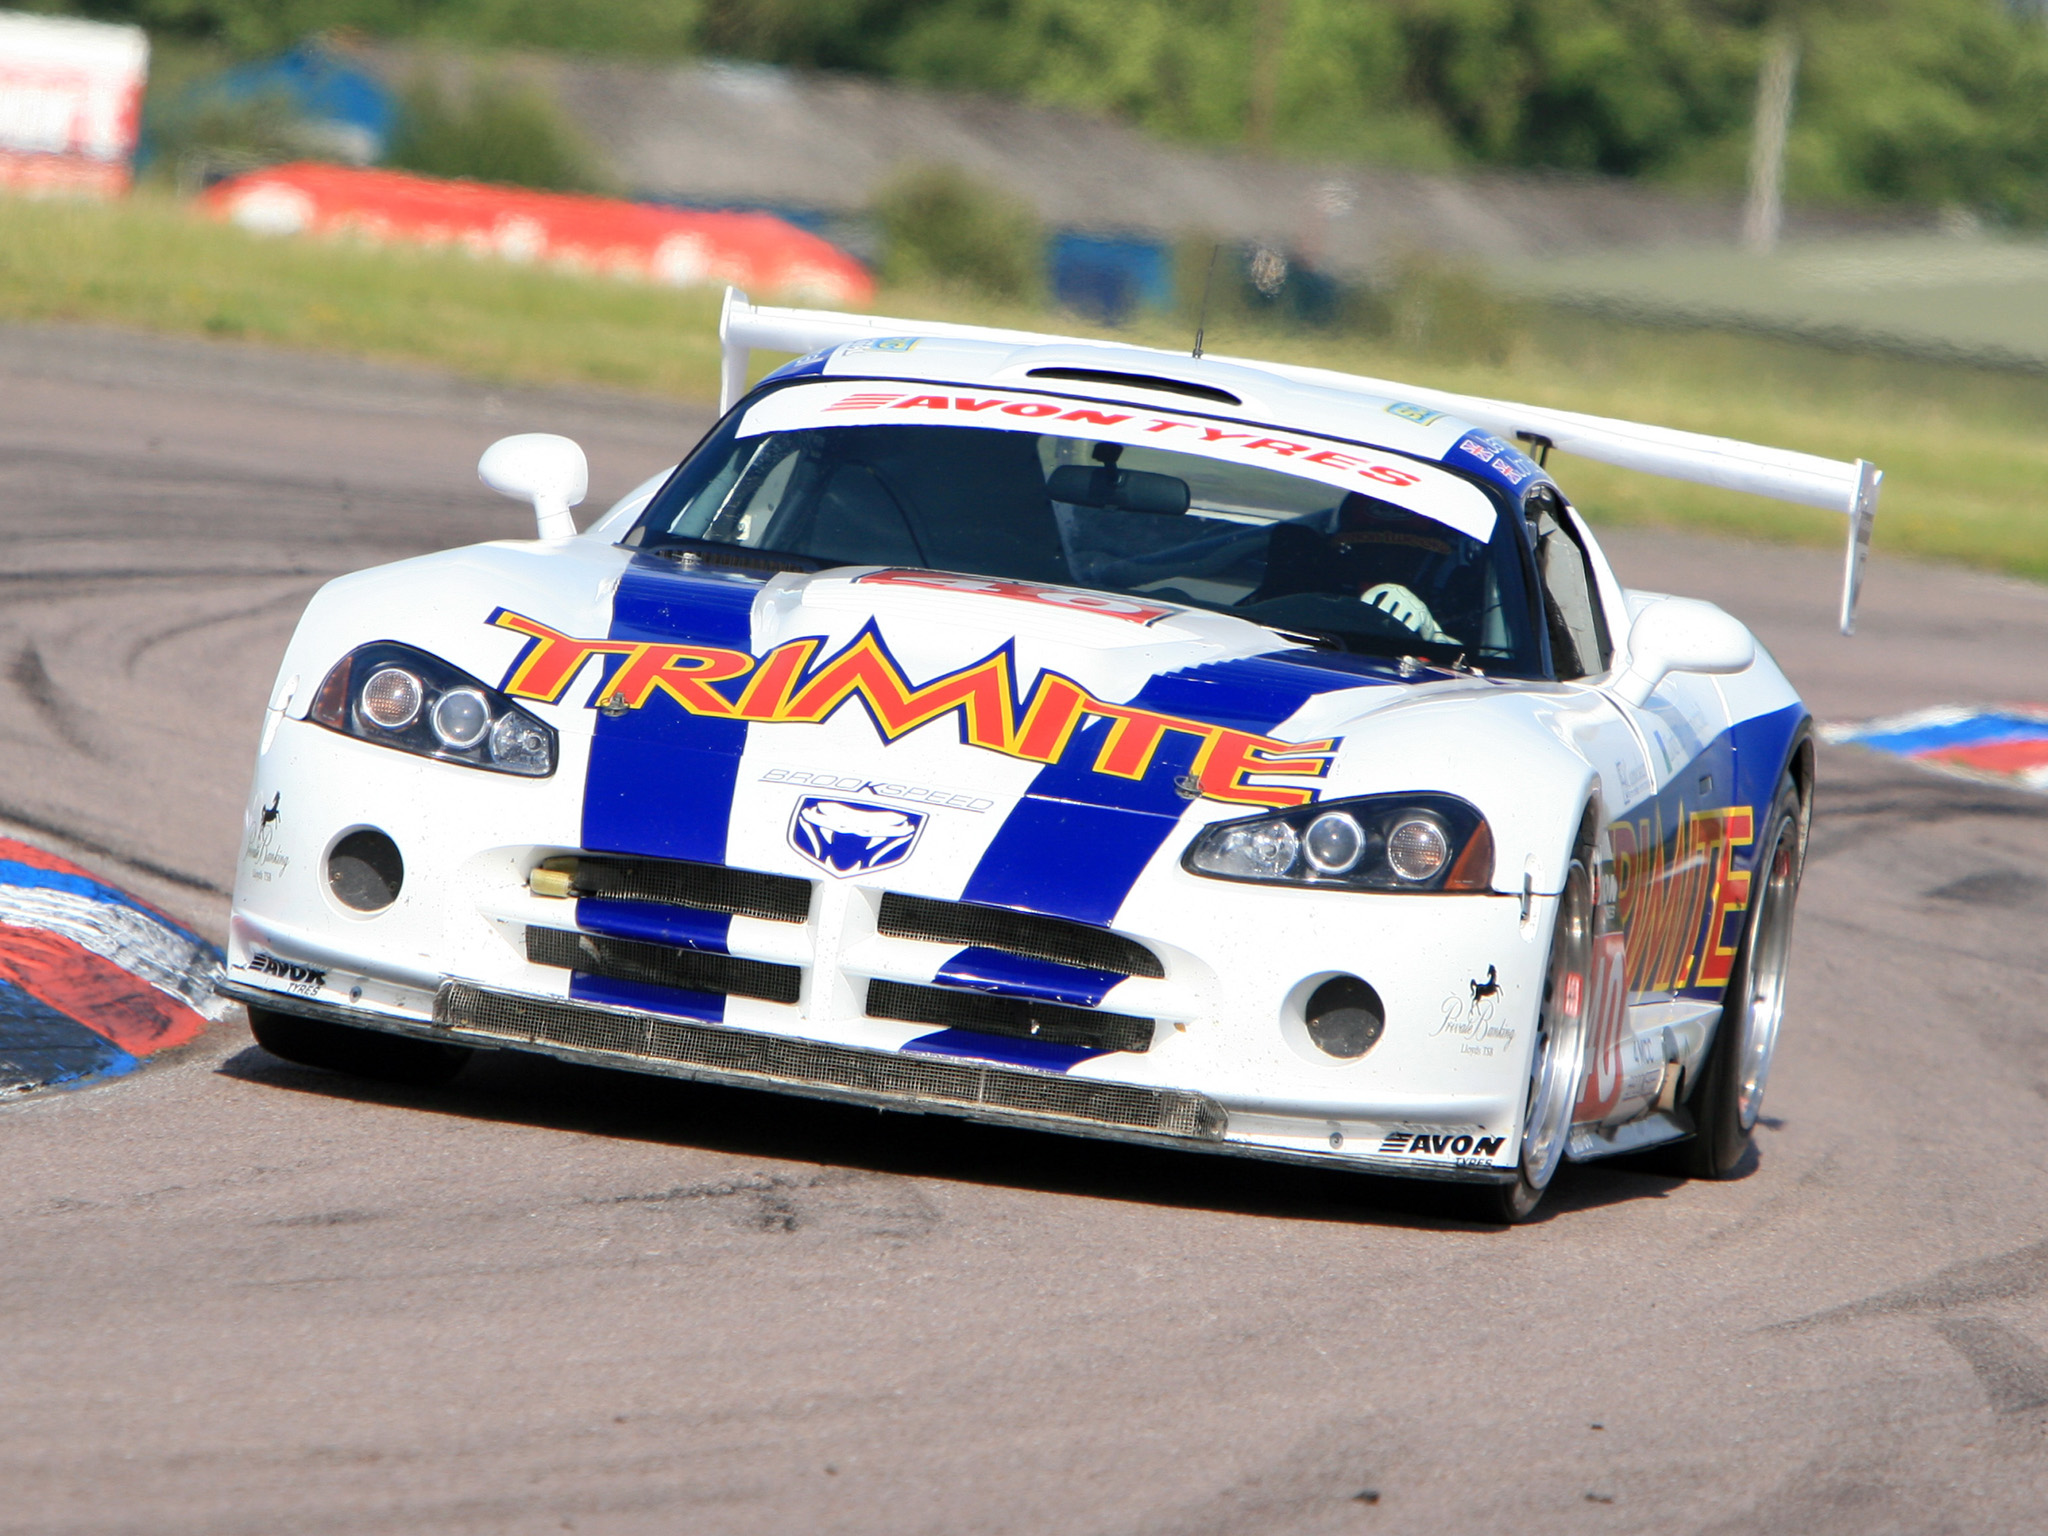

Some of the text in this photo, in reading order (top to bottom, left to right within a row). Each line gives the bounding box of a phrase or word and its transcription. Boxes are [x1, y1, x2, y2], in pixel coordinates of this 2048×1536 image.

[901, 395, 1422, 487] AVON TYRES
[483, 615, 1344, 808] TRIMITE
[761, 768, 995, 811] BROOKSPEED
[286, 982, 321, 997] TYRES
[1464, 999, 1515, 1053] Banking
[1408, 1134, 1507, 1157] AVON
